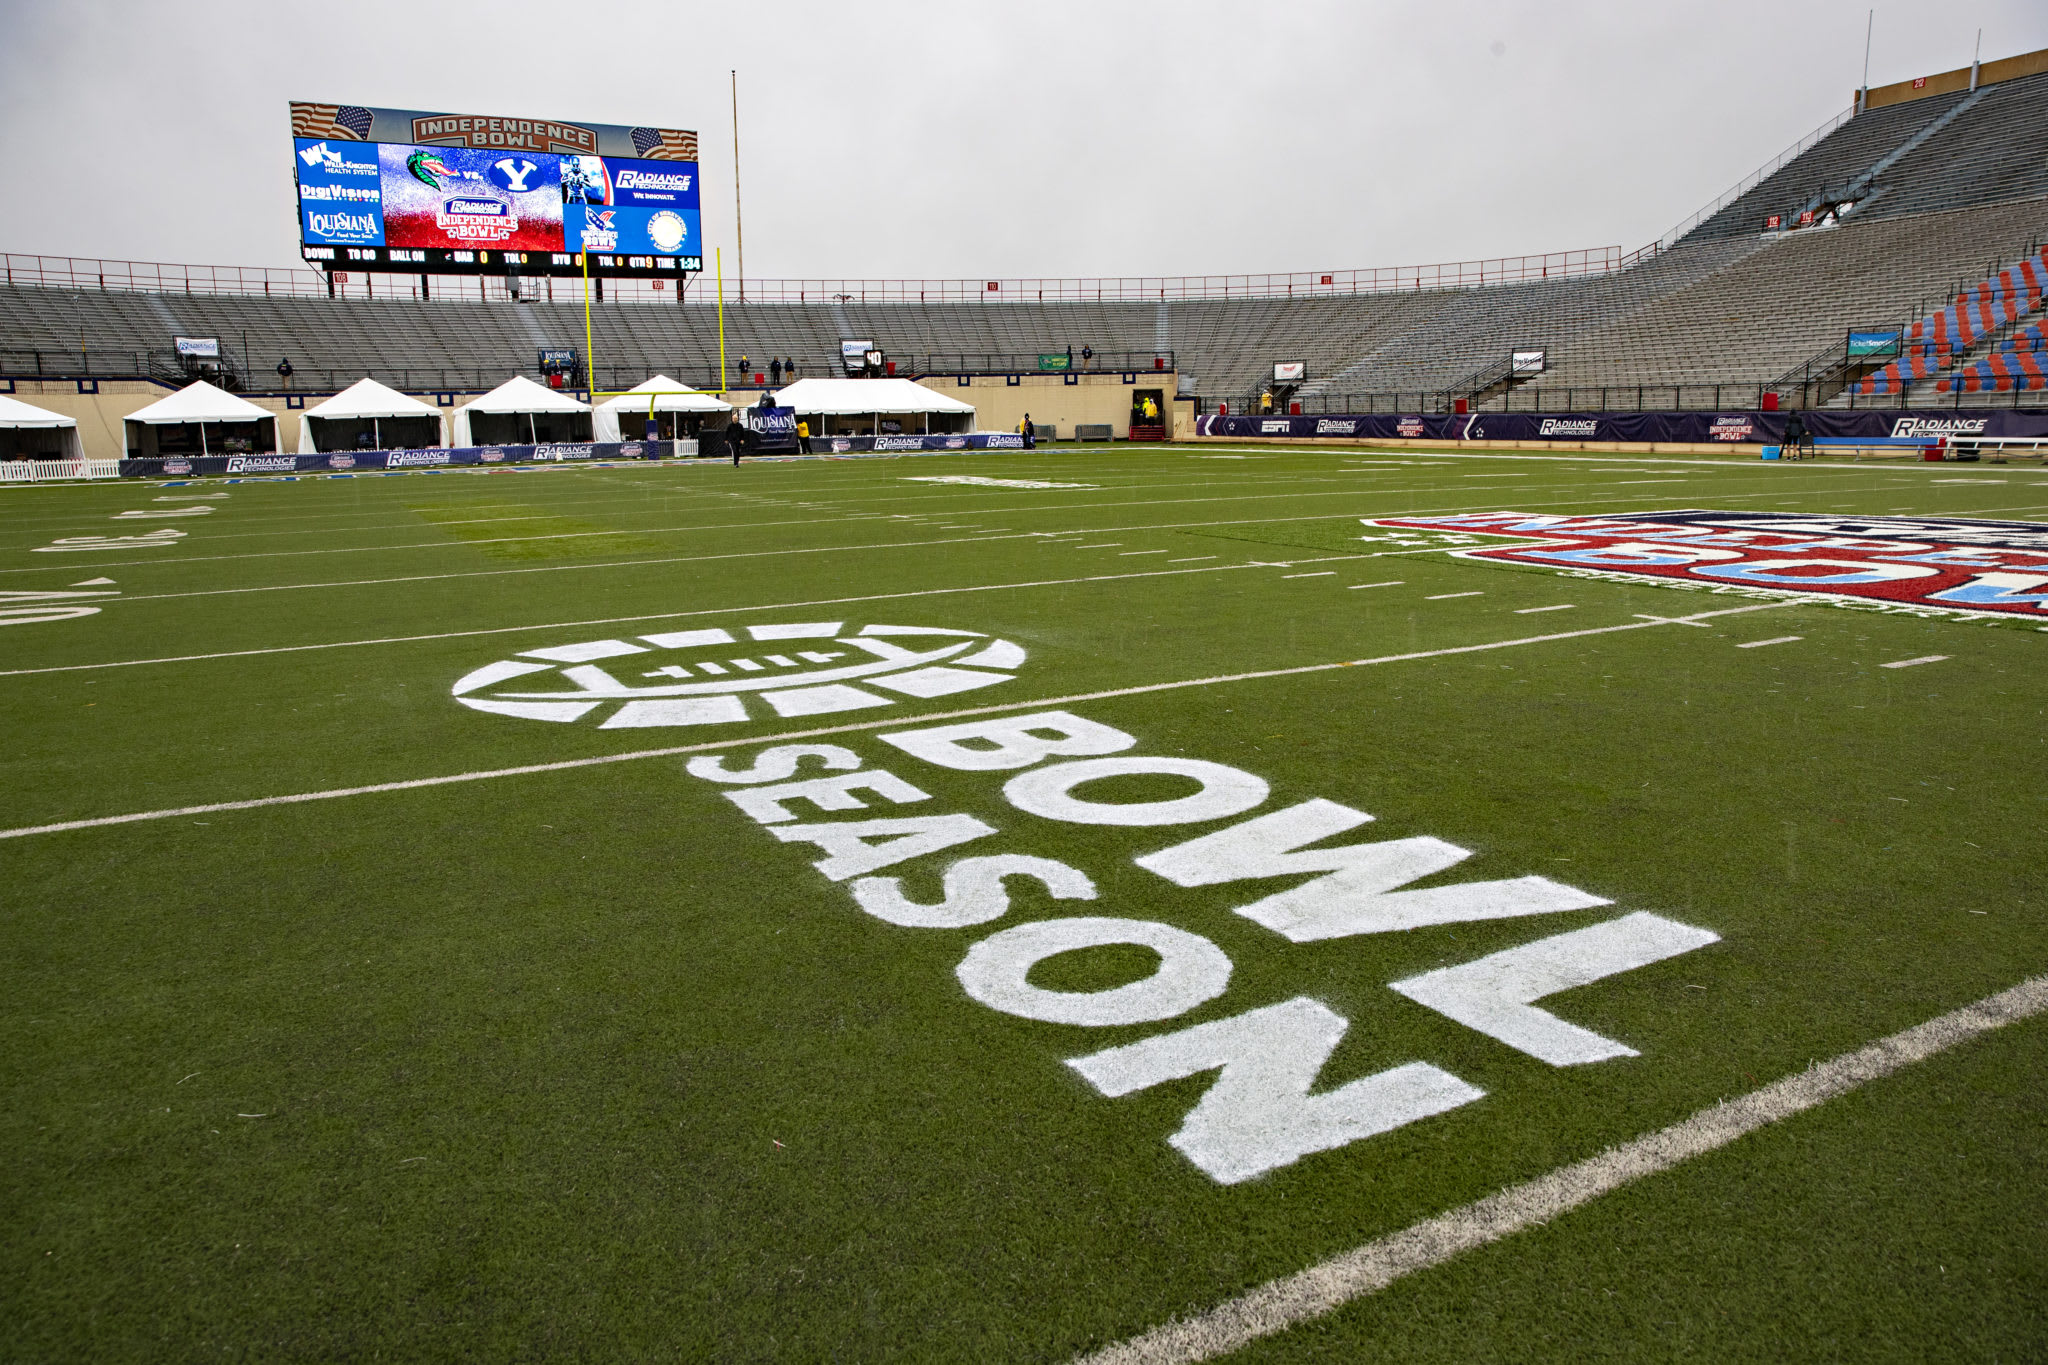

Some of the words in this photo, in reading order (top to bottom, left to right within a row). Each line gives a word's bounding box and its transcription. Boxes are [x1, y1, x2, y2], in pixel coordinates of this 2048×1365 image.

[421, 118, 590, 147] INDEPENDENCE
[472, 132, 542, 149] BOWL
[325, 167, 352, 175] HEALTH
[494, 158, 538, 191] Y
[615, 170, 692, 189] RADIANCE
[635, 183, 689, 191] TECHNOLOGIES
[308, 211, 379, 237] LOUISIANA
[440, 214, 518, 228] INDEPENDENCE
[458, 226, 498, 238] BOWL
[304, 247, 335, 260] DOWN
[347, 248, 361, 260] TO
[362, 249, 377, 261] GO
[389, 250, 411, 262] BALL
[412, 250, 425, 262] ON
[453, 251, 474, 263] UAB
[480, 250, 488, 264] 0
[504, 252, 521, 264] TOL
[521, 253, 528, 264] 0
[552, 253, 571, 265] BYU
[575, 254, 582, 267] 0
[598, 255, 614, 267] TOL
[617, 256, 623, 267] 0
[629, 256, 646, 268] QTR
[646, 256, 653, 269] 9
[656, 257, 675, 269] TIME
[679, 257, 701, 270] 1:34
[867, 351, 882, 366] 40
[749, 413, 798, 434] LOUISIANA
[1261, 420, 1290, 433] ESPN
[1317, 419, 1357, 433] RADIANCE
[1540, 419, 1597, 435] RADIANCE
[1709, 425, 1752, 434] INDEPENDENCE
[1891, 417, 1989, 438] RADIANCE
[987, 435, 1024, 448] RADIAN
[1719, 432, 1741, 440] BOWL
[874, 437, 924, 450] RADIANCE
[387, 450, 451, 467] RADIANCE
[533, 445, 593, 460] RADIANCE
[226, 457, 297, 473] RADIANCE
[244, 465, 295, 473] TECHNOLOGIES
[877, 710, 1722, 1068] BOWL
[685, 743, 1488, 1187] SEASON
